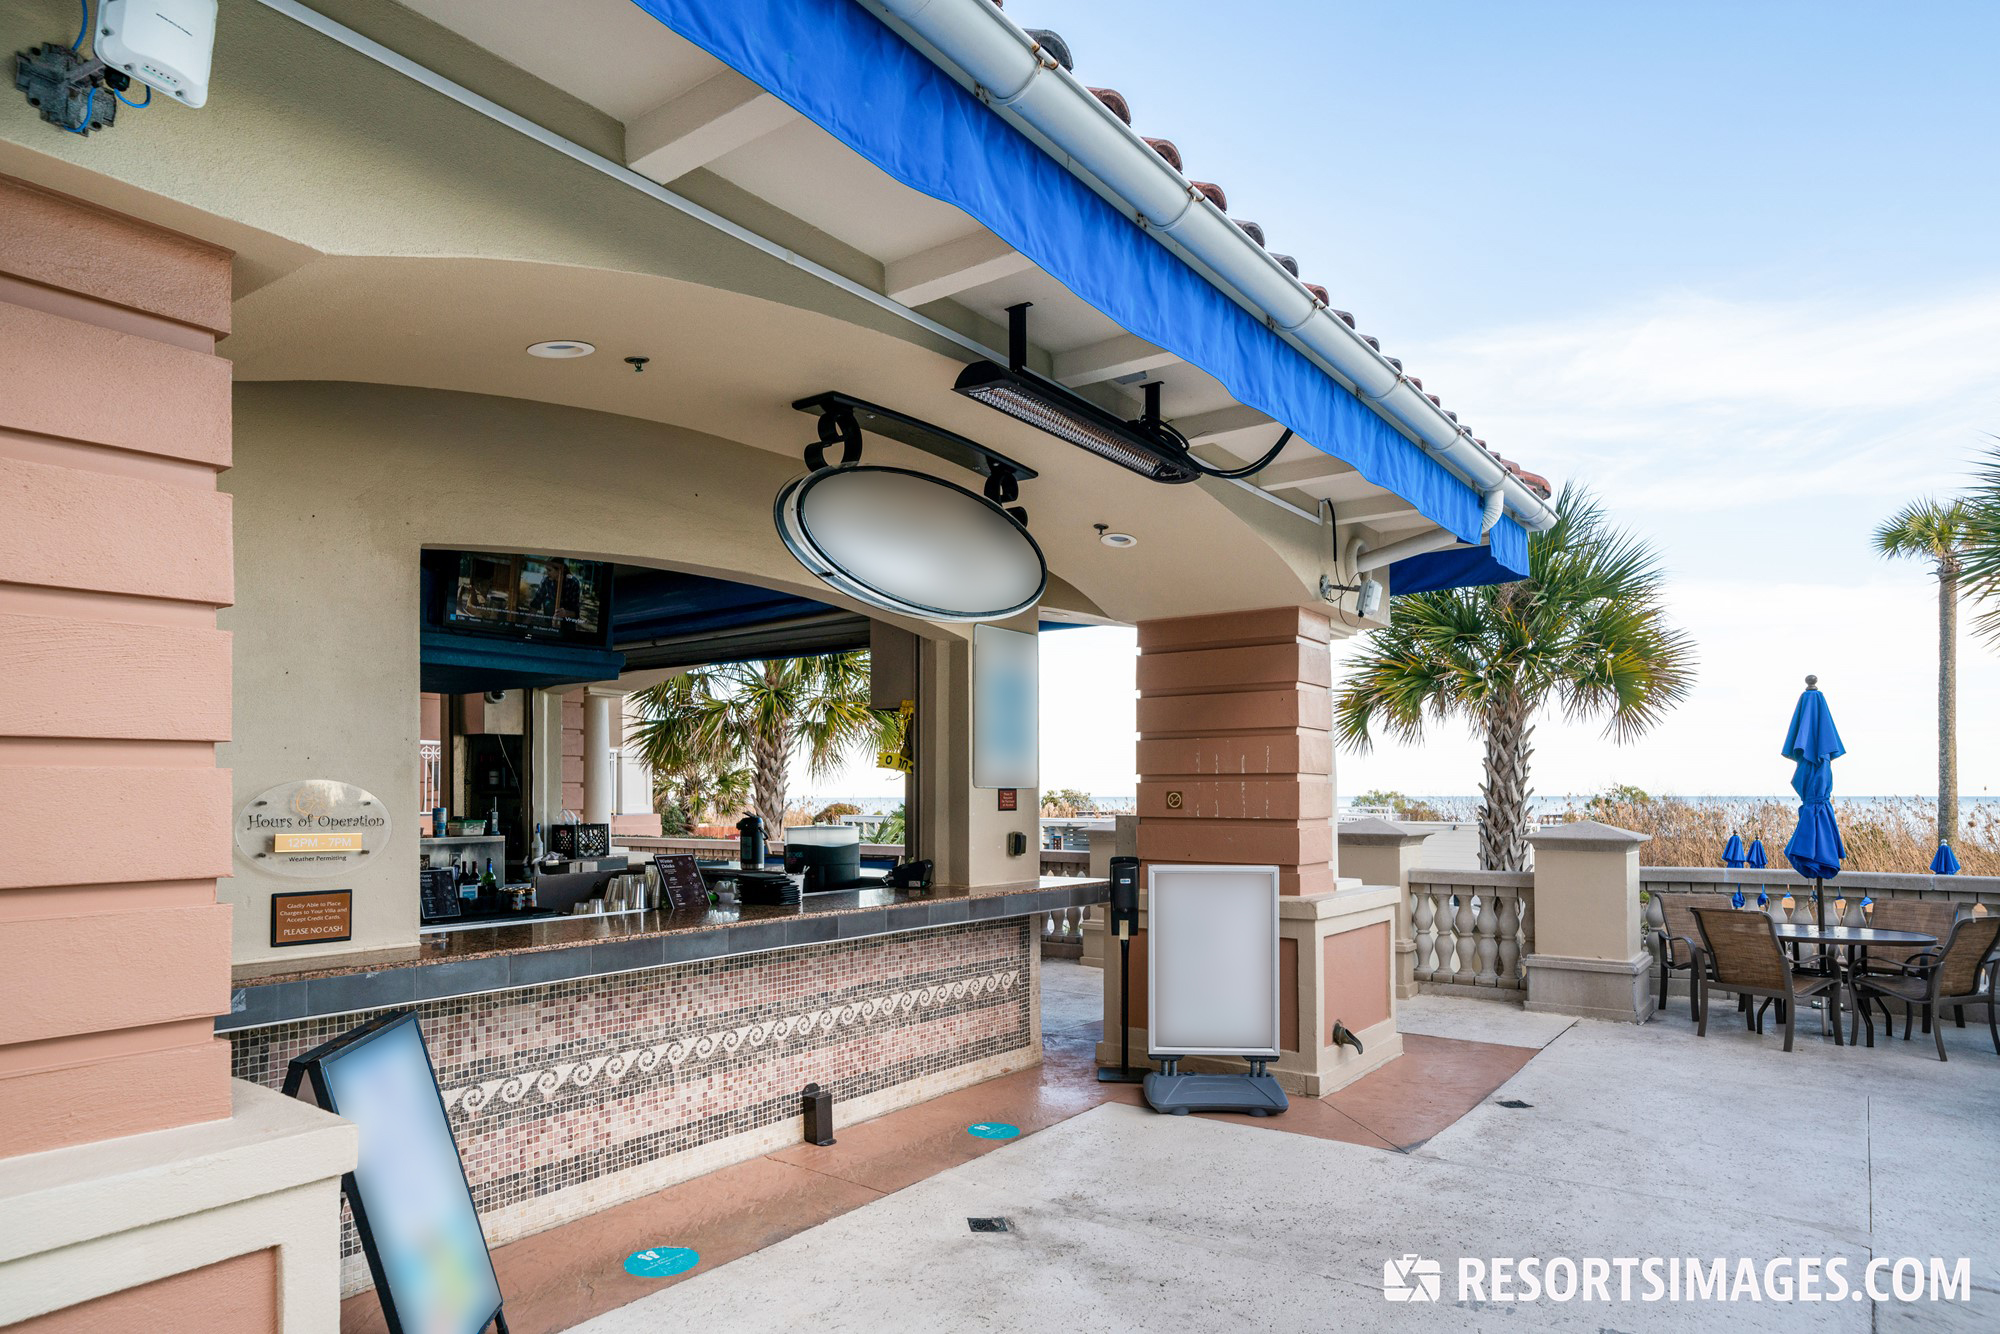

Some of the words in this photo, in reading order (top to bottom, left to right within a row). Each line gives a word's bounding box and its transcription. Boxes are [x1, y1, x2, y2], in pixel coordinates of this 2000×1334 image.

[247, 814, 292, 830] Hours
[298, 814, 314, 828] of
[318, 815, 385, 830] Operation
[288, 837, 318, 848] 12PM
[328, 837, 352, 847] 7PM
[283, 927, 309, 936] PLEASE
[310, 926, 322, 934] NO
[323, 925, 343, 933] CASH
